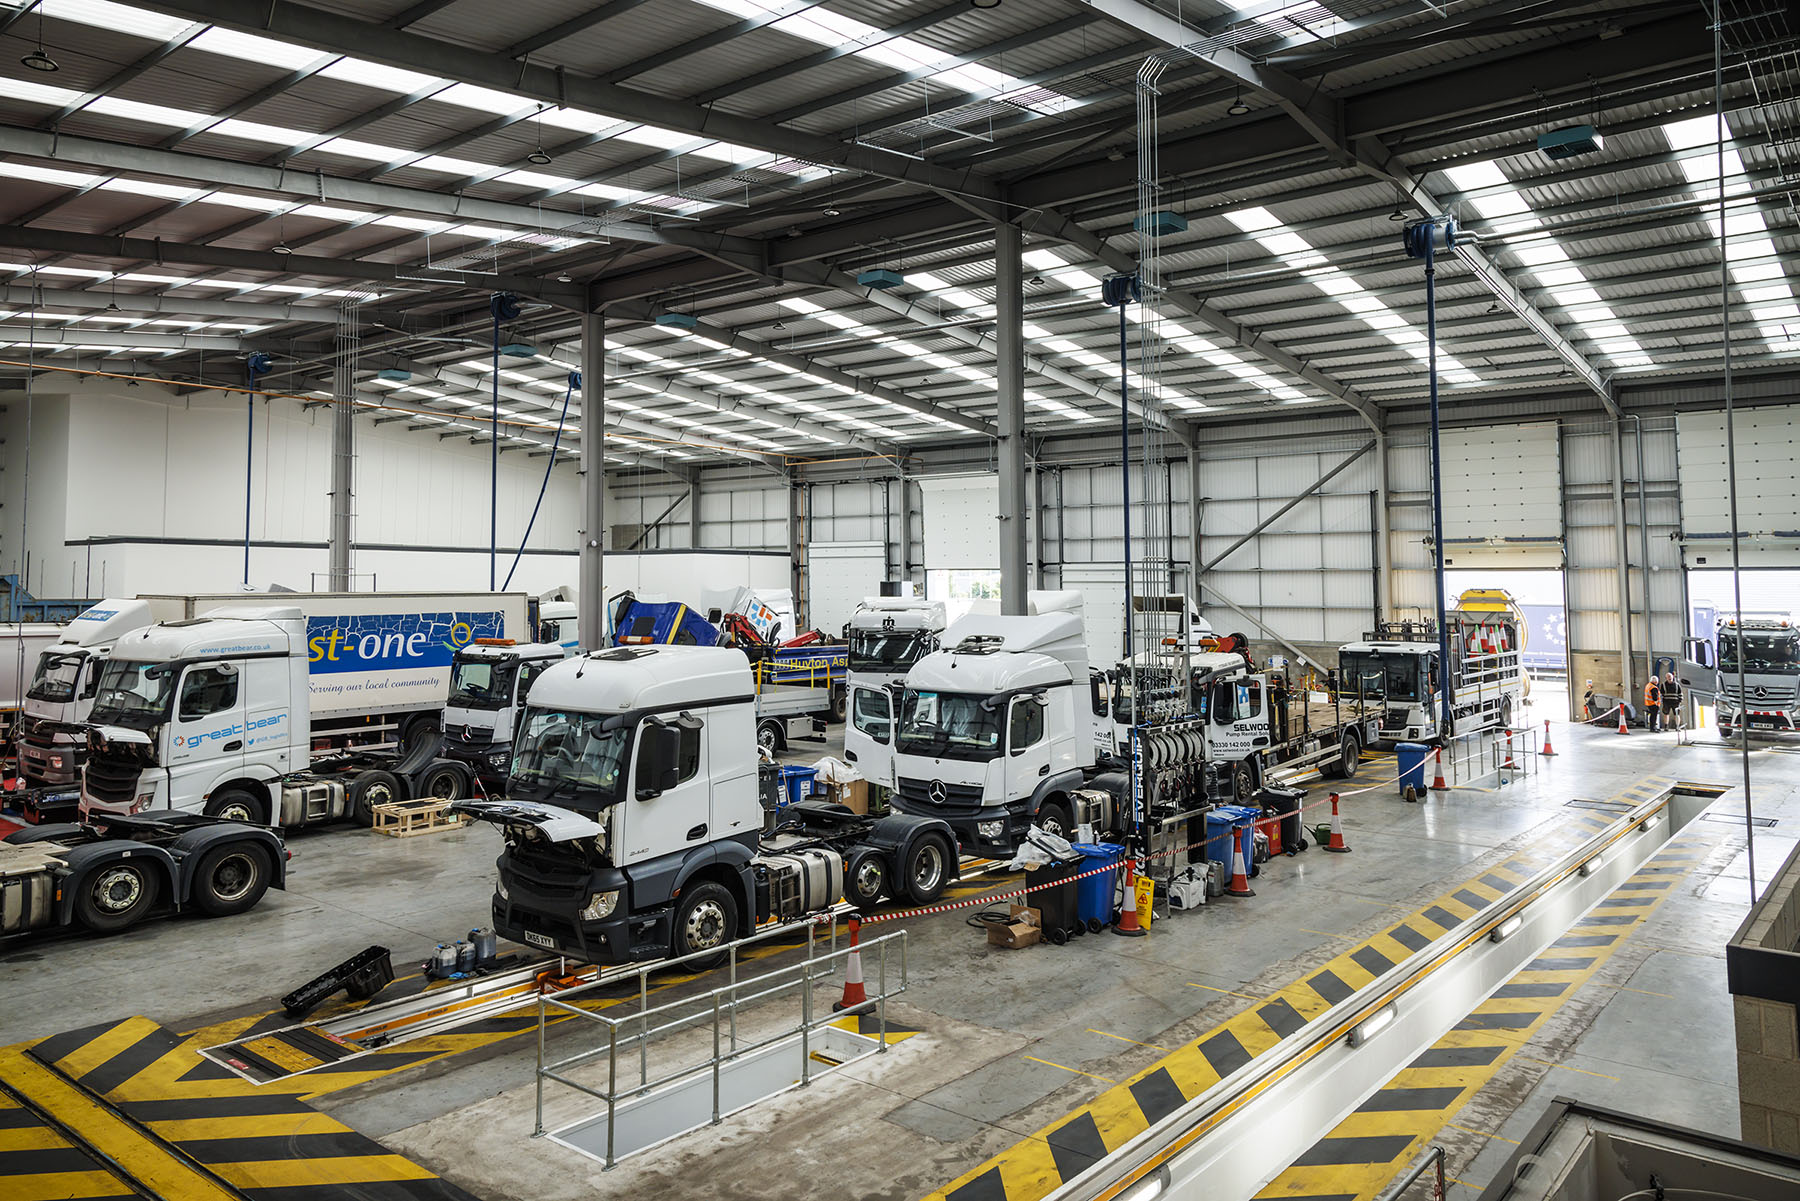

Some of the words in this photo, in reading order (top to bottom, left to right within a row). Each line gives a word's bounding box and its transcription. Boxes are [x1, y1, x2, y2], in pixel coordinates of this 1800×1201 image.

[346, 683, 362, 691] our
[365, 678, 389, 690] local
[391, 677, 440, 688] community
[187, 724, 243, 748] great
[246, 713, 287, 732] bear
